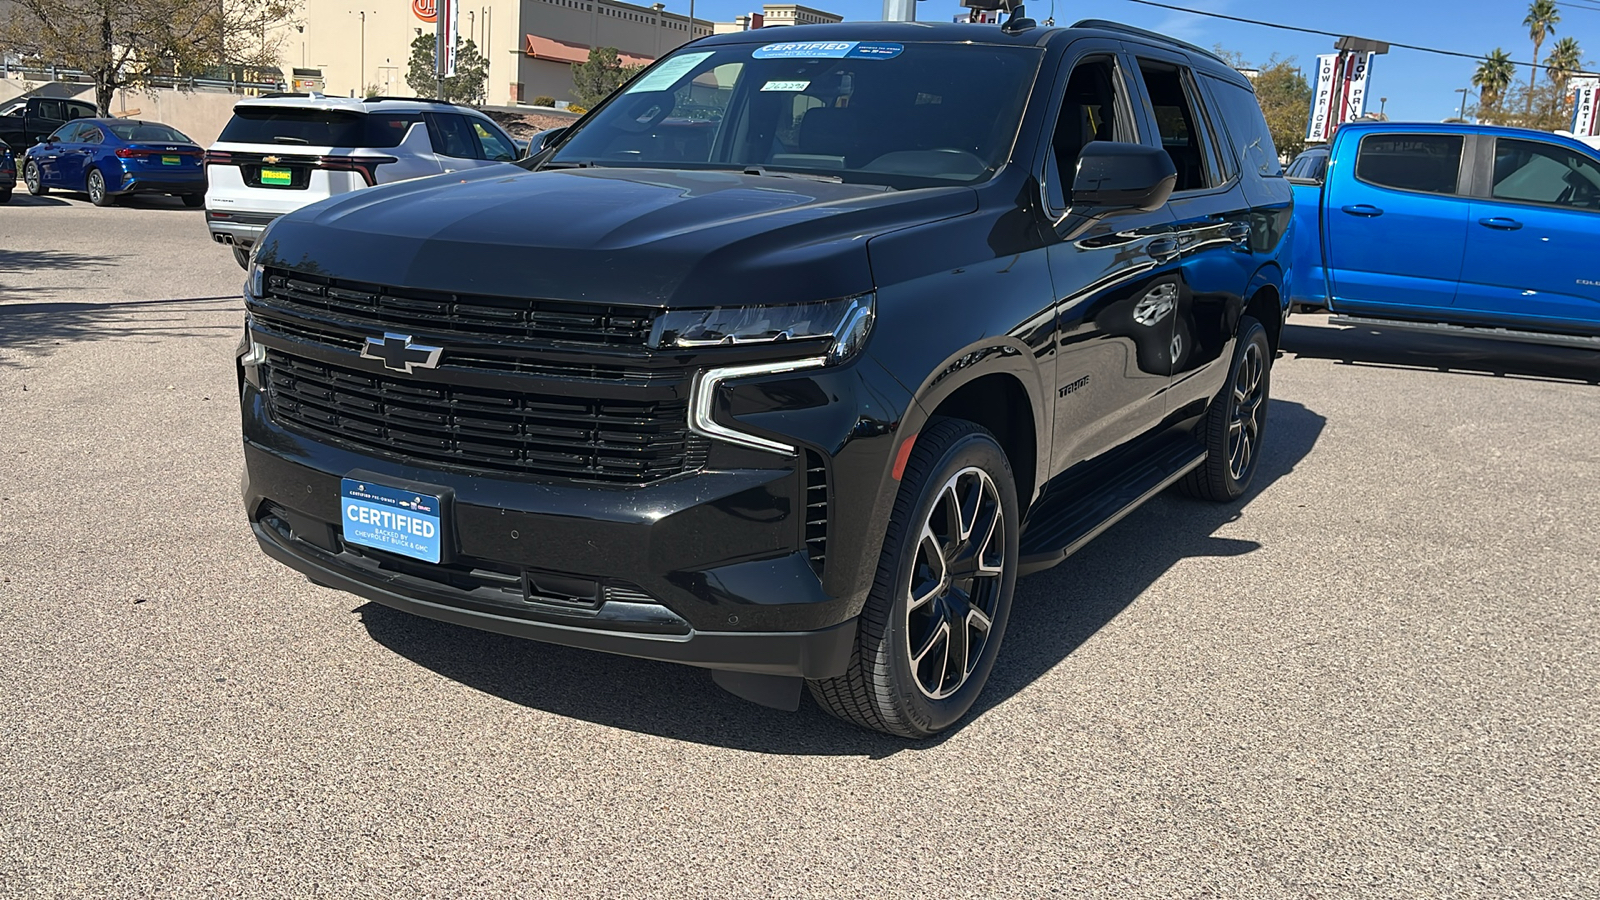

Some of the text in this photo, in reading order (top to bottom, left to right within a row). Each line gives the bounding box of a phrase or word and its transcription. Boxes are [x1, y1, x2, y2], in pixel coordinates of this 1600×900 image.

[762, 43, 849, 51] CERTIFIED
[1354, 57, 1365, 81] LOW
[1313, 59, 1331, 137] LOW PRICES
[1059, 374, 1090, 398] TAHOE
[349, 490, 372, 498] CERTIFIED
[347, 505, 435, 538] CERTIFIED
[354, 529, 390, 542] CHEVROLET
[391, 537, 409, 547] BUICK
[414, 543, 429, 553] GMC
[375, 528, 409, 541] BACKED BY
